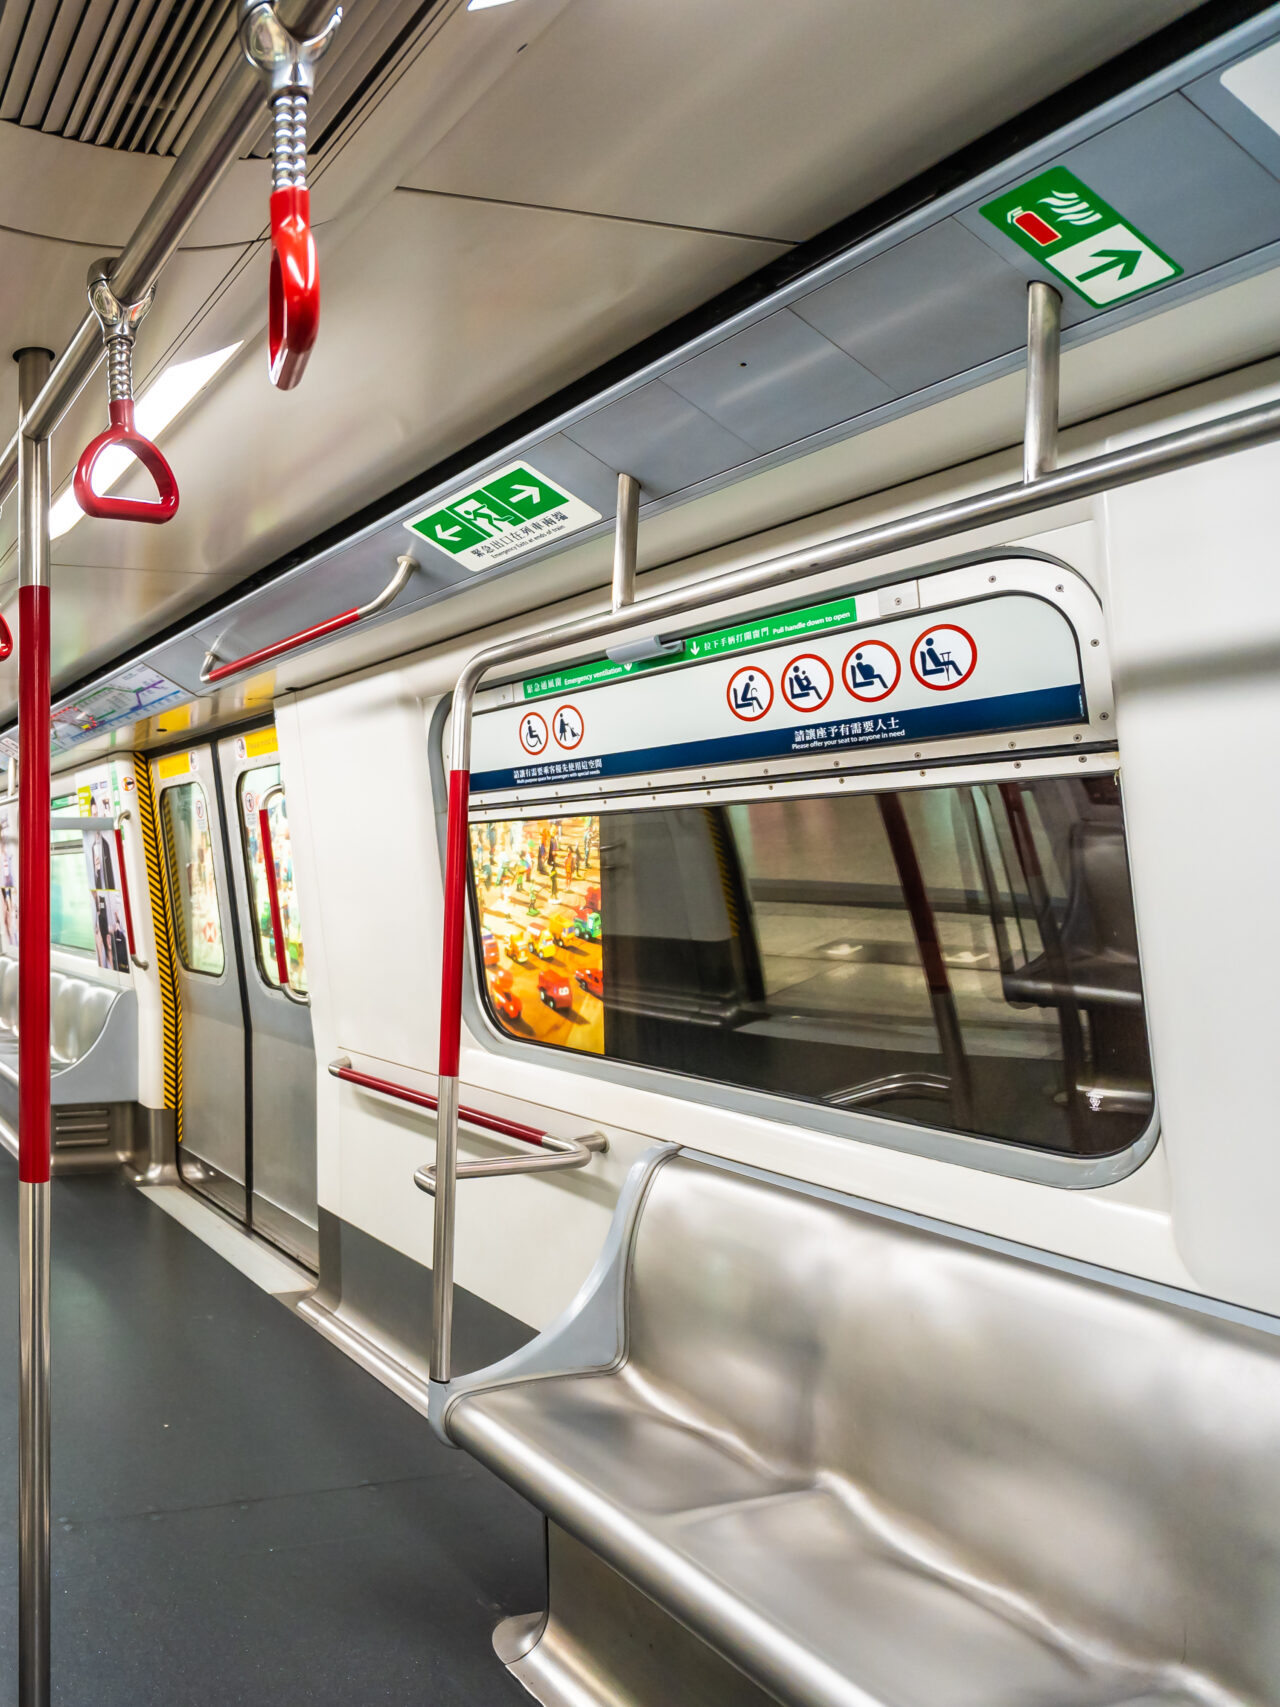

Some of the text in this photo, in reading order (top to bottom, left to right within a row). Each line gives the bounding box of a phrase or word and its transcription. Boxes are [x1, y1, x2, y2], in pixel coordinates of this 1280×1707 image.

[491, 546, 518, 559] Emergency
[785, 622, 805, 631] handle
[806, 618, 825, 626] down
[832, 612, 850, 621] open
[564, 667, 622, 686] Emergency ventilation
[794, 717, 900, 742] 請讓座予有需要人士
[824, 740, 837, 748] your
[858, 734, 880, 742] anyone
[889, 729, 906, 738] need
